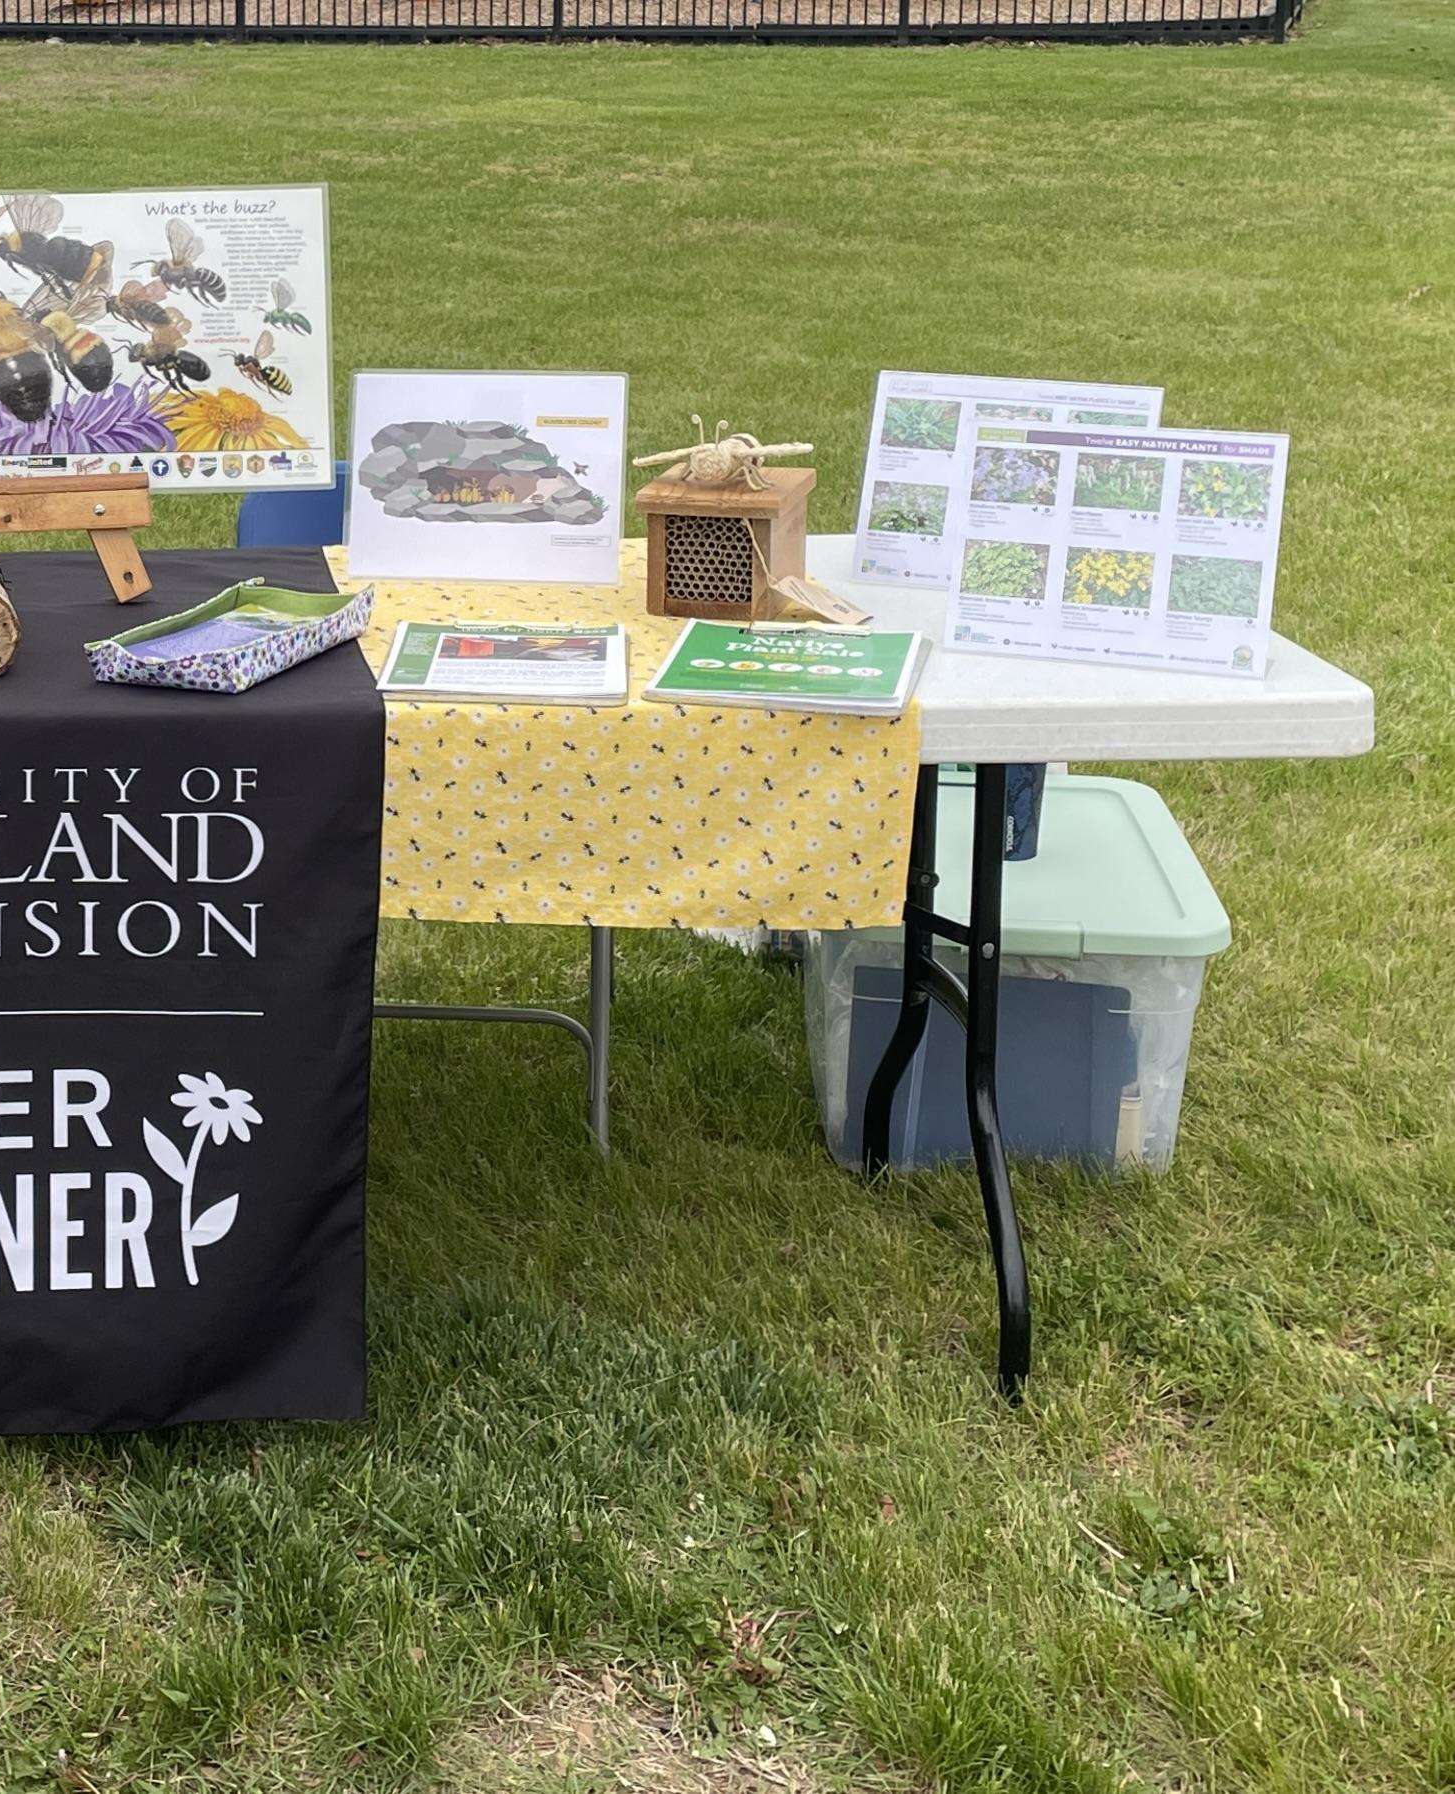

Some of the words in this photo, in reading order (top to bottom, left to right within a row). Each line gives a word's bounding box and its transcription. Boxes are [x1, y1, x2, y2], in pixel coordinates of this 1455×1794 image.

[144, 201, 198, 216] What's
[203, 200, 228, 215] the
[234, 200, 277, 215] buzz?
[1085, 436, 1114, 446] Twelve
[1115, 438, 1140, 448] EASY
[1142, 440, 1178, 450] NATIVE
[1179, 442, 1218, 453] PLANTS
[1238, 446, 1271, 456] SHADE
[725, 642, 796, 655] Plant
[804, 647, 865, 657] Sale
[753, 635, 847, 650] Native
[181, 768, 257, 802] OF
